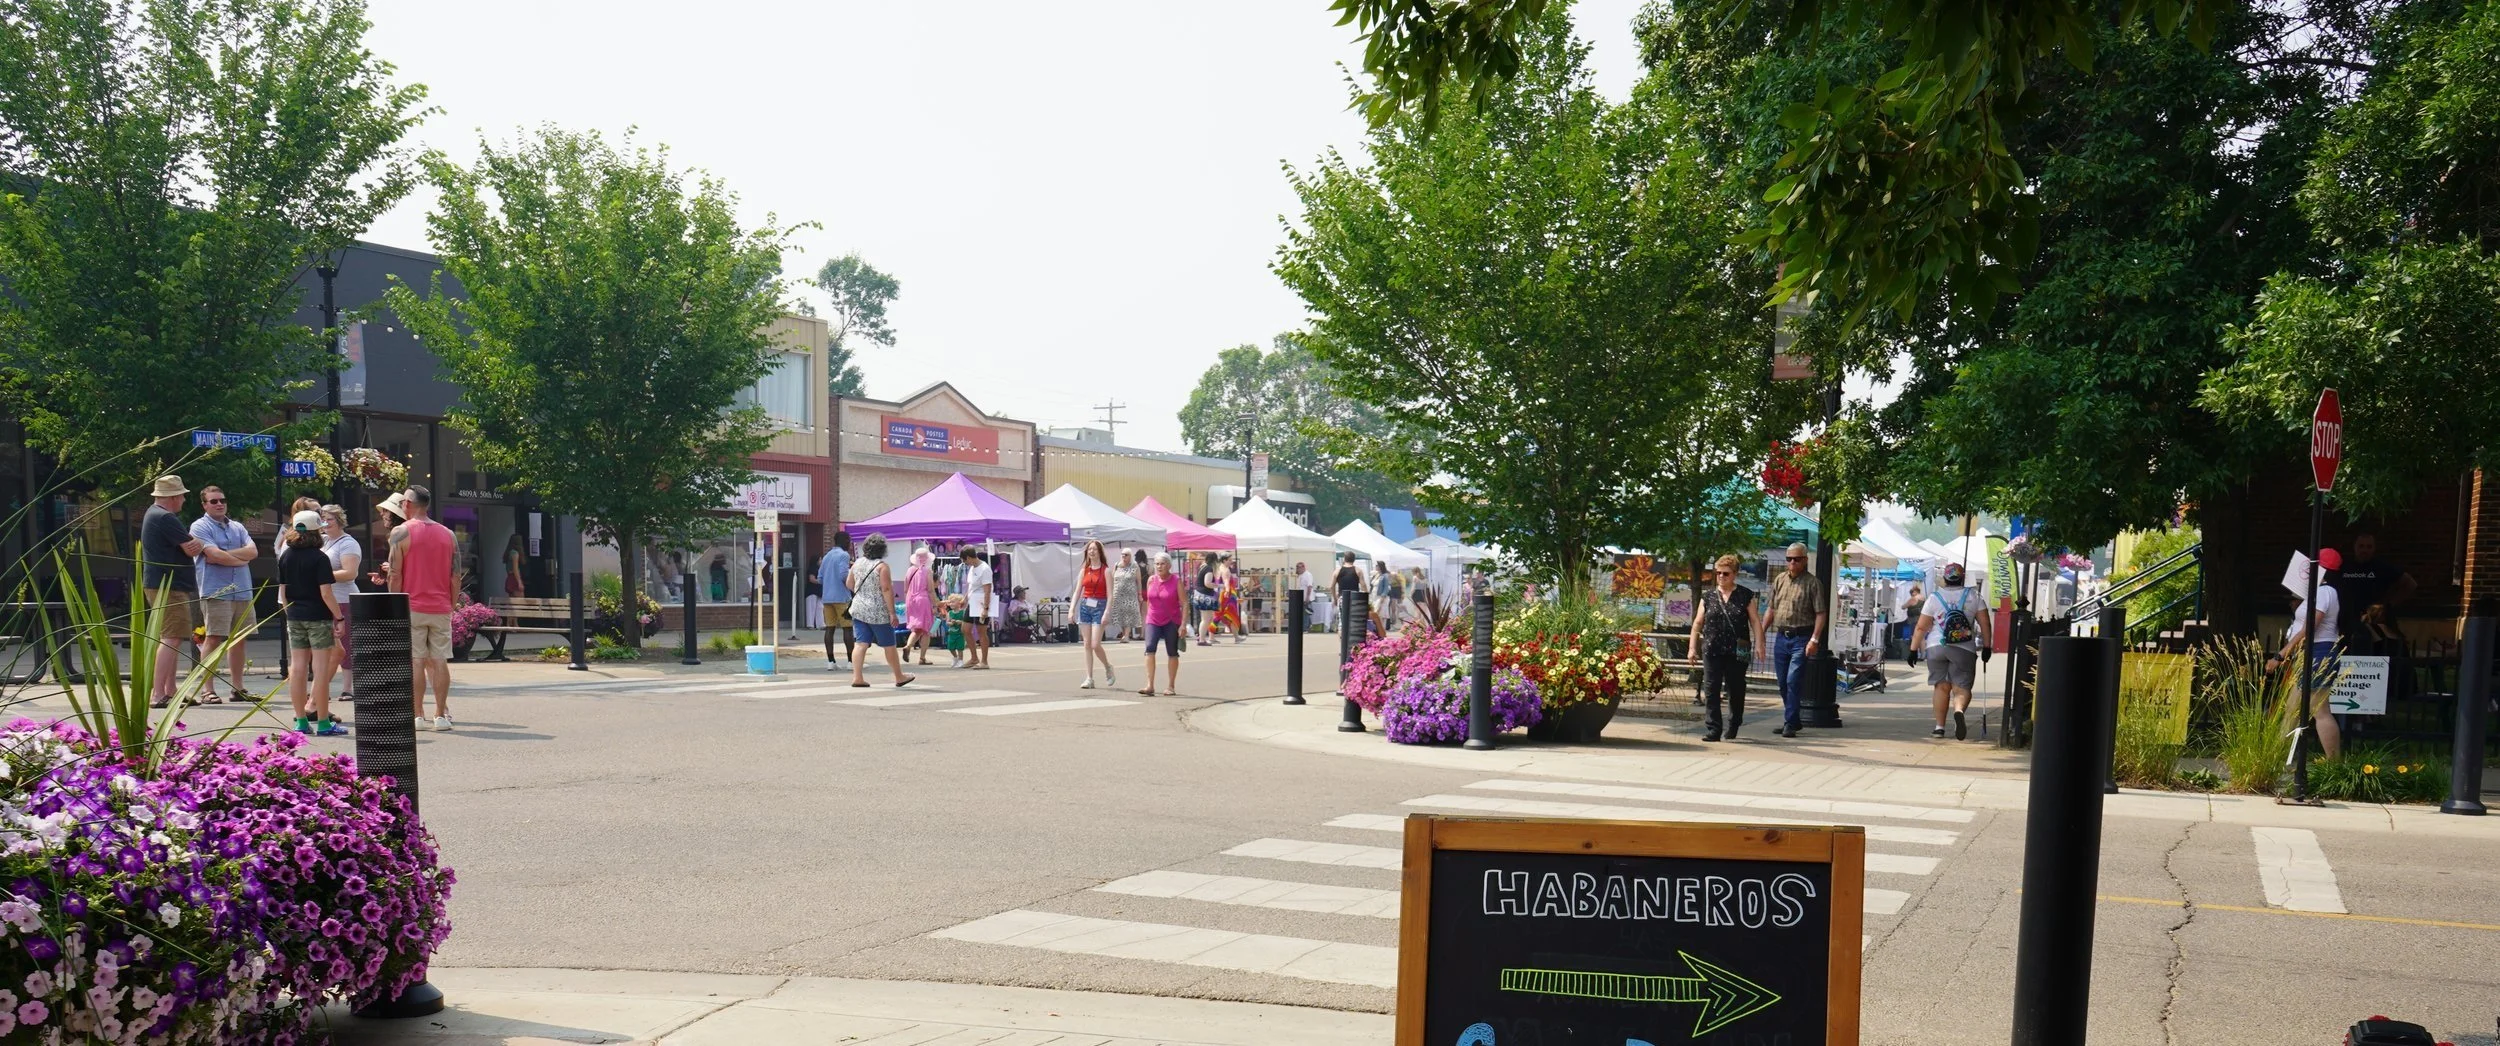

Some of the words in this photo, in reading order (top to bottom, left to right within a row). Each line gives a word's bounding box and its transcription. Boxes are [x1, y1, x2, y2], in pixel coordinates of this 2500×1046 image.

[891, 426, 912, 434] CANADA
[926, 430, 944, 438] POSTES
[953, 436, 972, 450] Leduc
[2314, 420, 2340, 459] STOP
[284, 462, 300, 475] 48A
[302, 462, 311, 475] ST
[458, 490, 477, 498] 4809A
[479, 491, 492, 499] 50th
[2329, 689, 2357, 698] Shop
[1483, 868, 1816, 929] HABANEROS
